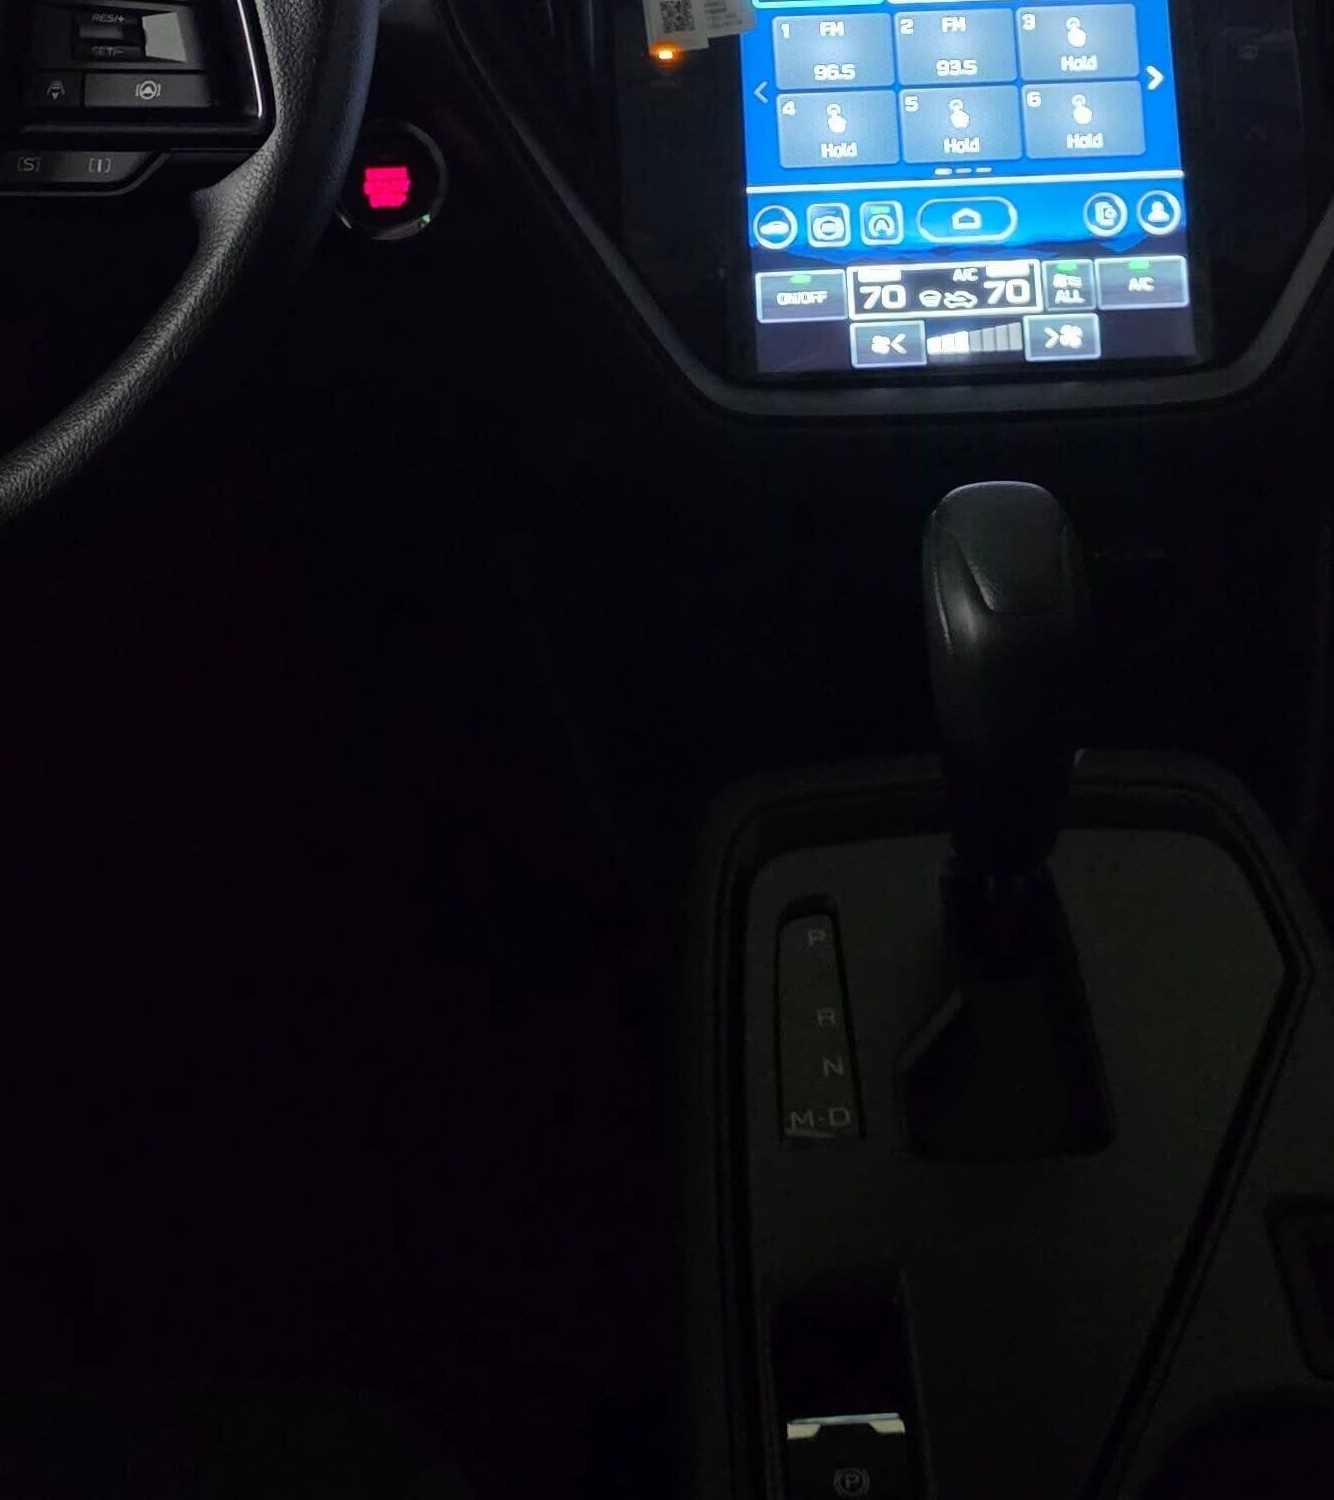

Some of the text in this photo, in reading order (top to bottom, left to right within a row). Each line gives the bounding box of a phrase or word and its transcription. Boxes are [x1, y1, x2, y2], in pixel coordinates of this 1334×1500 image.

[781, 21, 845, 40] 1 FM
[899, 16, 967, 35] 2 FM
[1022, 13, 1037, 31] 3
[813, 63, 856, 81] 96.5
[1060, 55, 1098, 72] Hold
[782, 100, 797, 116] 4
[904, 96, 918, 112] 5
[1026, 91, 1042, 108] 6
[943, 136, 980, 154] Hold
[1066, 132, 1104, 149] Hold
[820, 141, 858, 159] Hold
[776, 290, 828, 306] ON/OFF
[859, 283, 907, 310] 70
[983, 278, 1030, 305] 70
[1054, 289, 1086, 304] ALL
[808, 929, 827, 946] P
[817, 1008, 837, 1027] R
[822, 1056, 844, 1077] N
